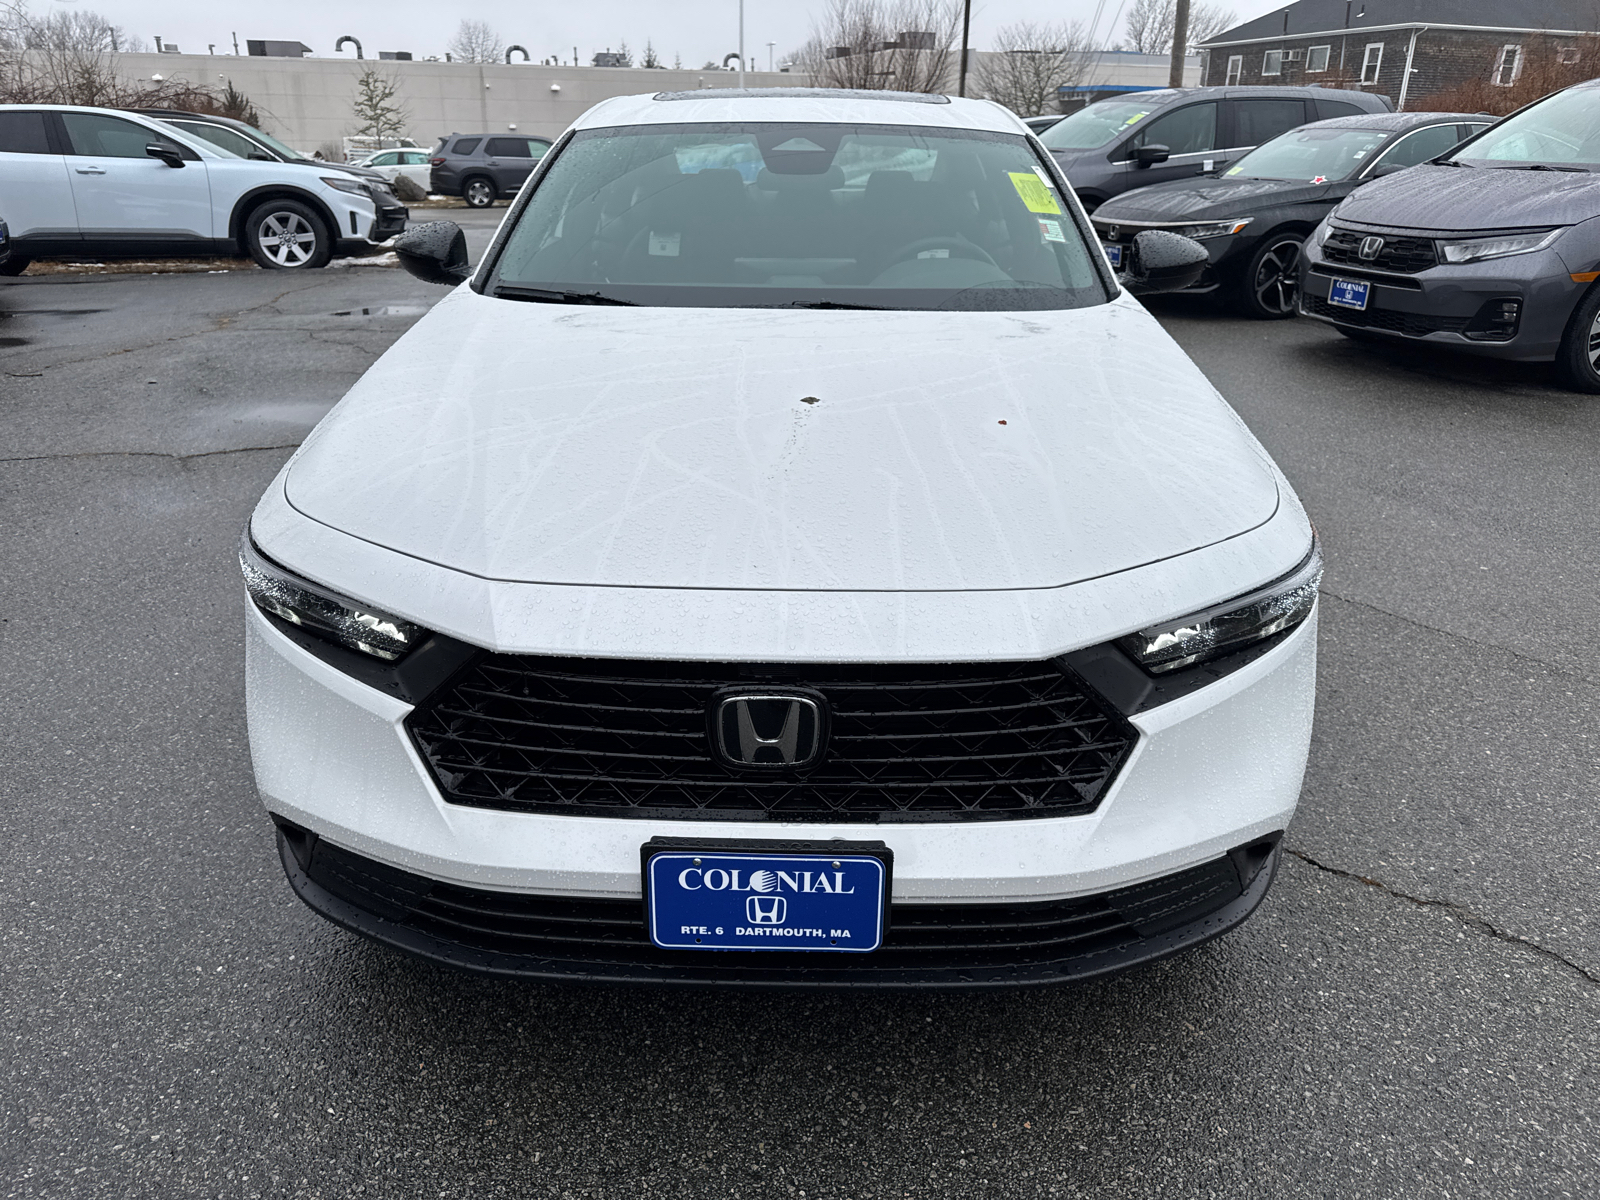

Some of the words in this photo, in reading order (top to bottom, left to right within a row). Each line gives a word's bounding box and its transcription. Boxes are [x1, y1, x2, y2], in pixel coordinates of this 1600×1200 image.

[678, 868, 855, 894] COLONIAL
[681, 926, 712, 935] RTE.
[715, 926, 724, 935] 6
[735, 927, 826, 938] DARTMOUTH,
[830, 929, 852, 938] MA
